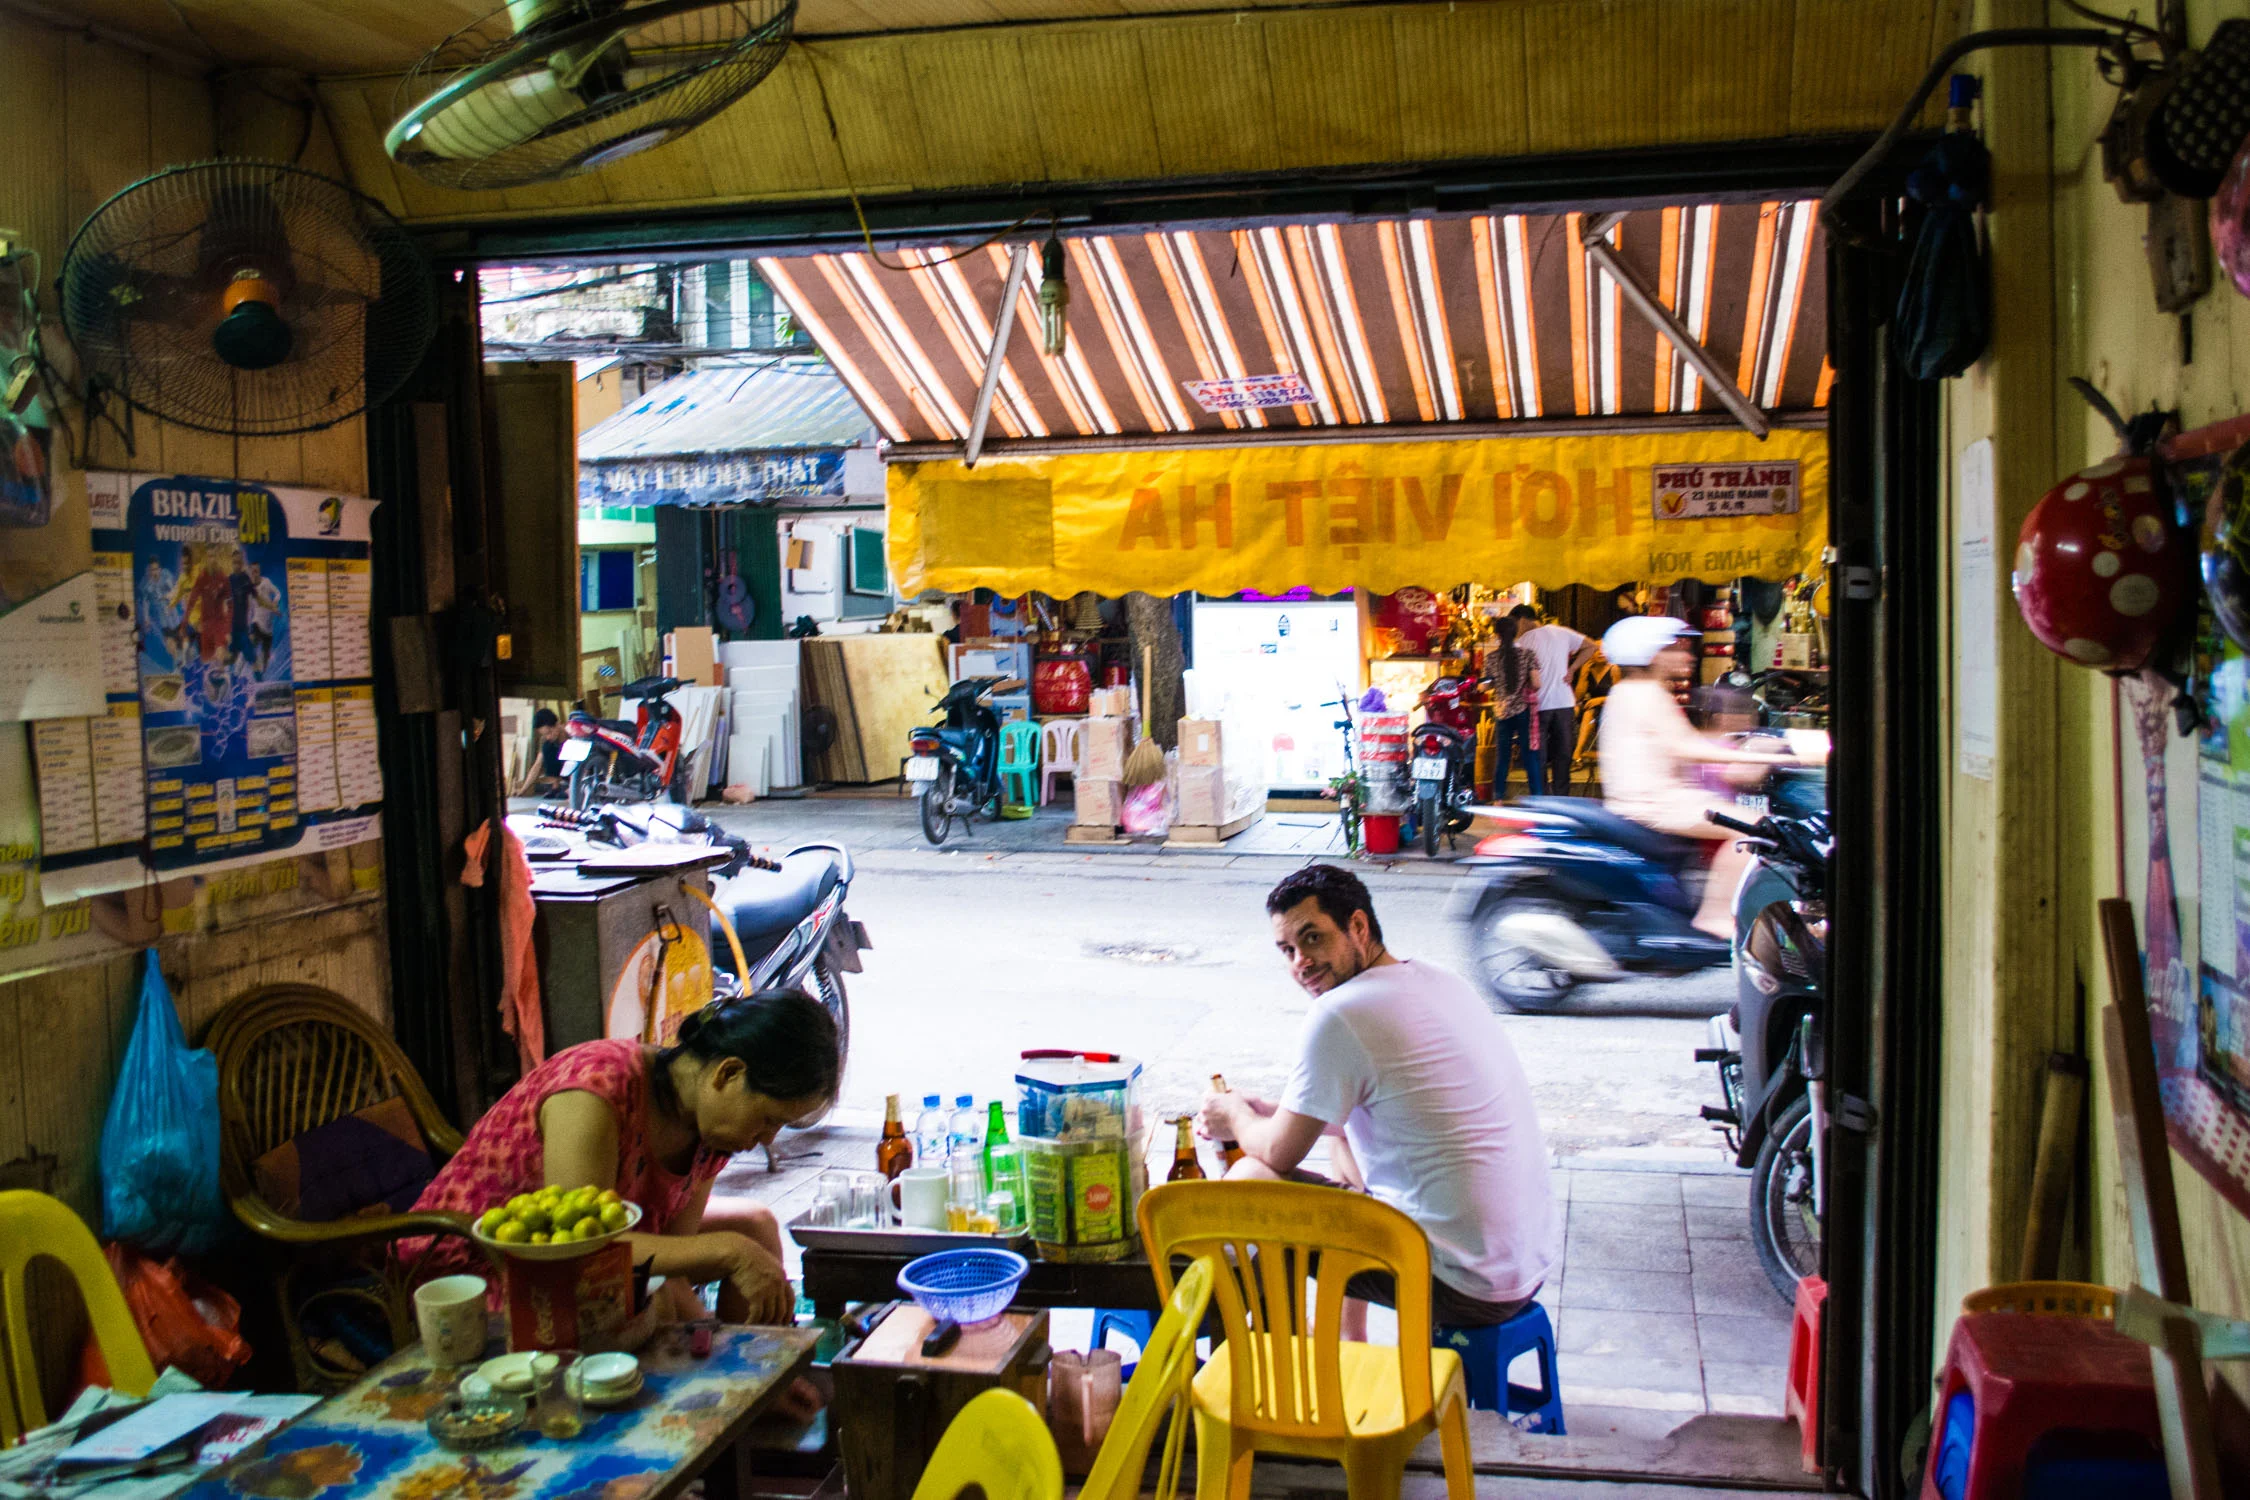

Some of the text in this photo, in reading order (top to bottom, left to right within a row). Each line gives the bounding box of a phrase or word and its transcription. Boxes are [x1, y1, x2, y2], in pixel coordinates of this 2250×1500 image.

[1657, 467, 1705, 489] PHÚ
[151, 488, 271, 544] BRAZIL 2014
[154, 523, 238, 544] WORLD CUP
